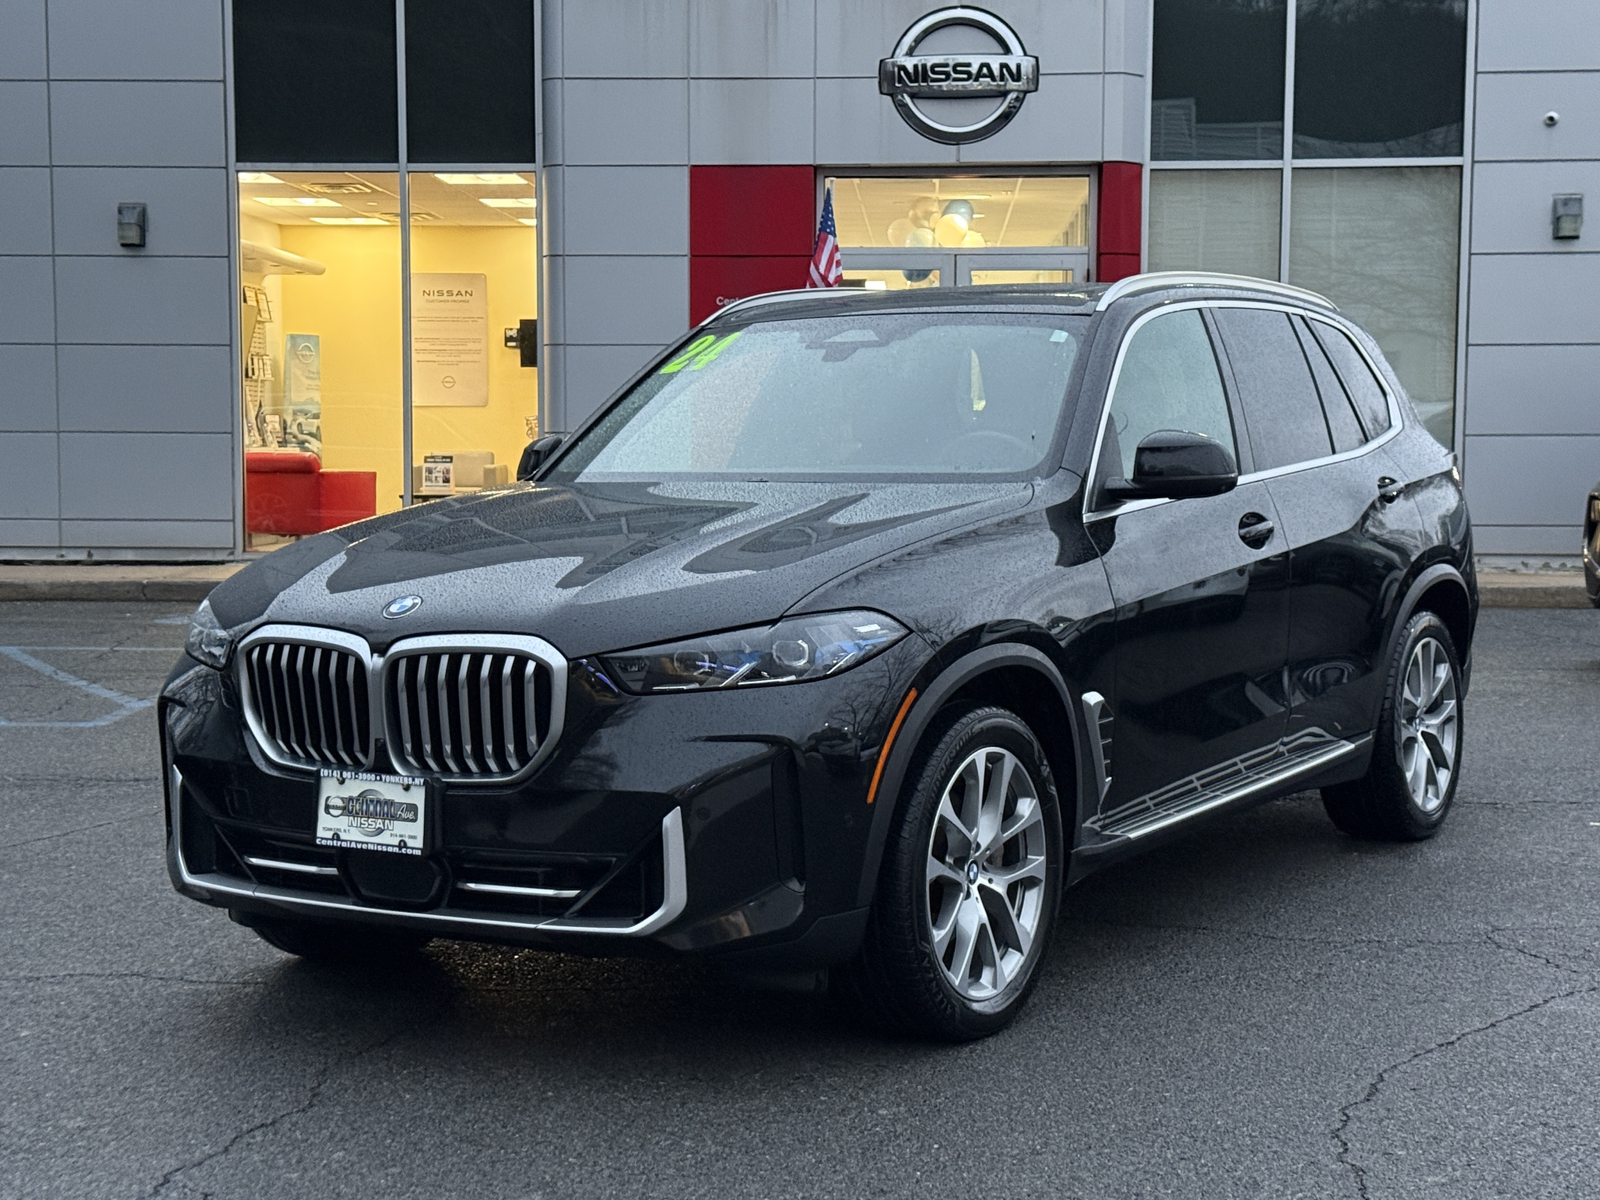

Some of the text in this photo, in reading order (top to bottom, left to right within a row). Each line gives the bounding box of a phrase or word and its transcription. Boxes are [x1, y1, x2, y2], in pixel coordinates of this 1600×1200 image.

[896, 62, 1022, 85] NISSAN
[422, 289, 473, 297] NISSAN
[659, 331, 742, 375] 24
[348, 816, 395, 831] NISSAN
[315, 838, 422, 855] CentralAveNissan.com
